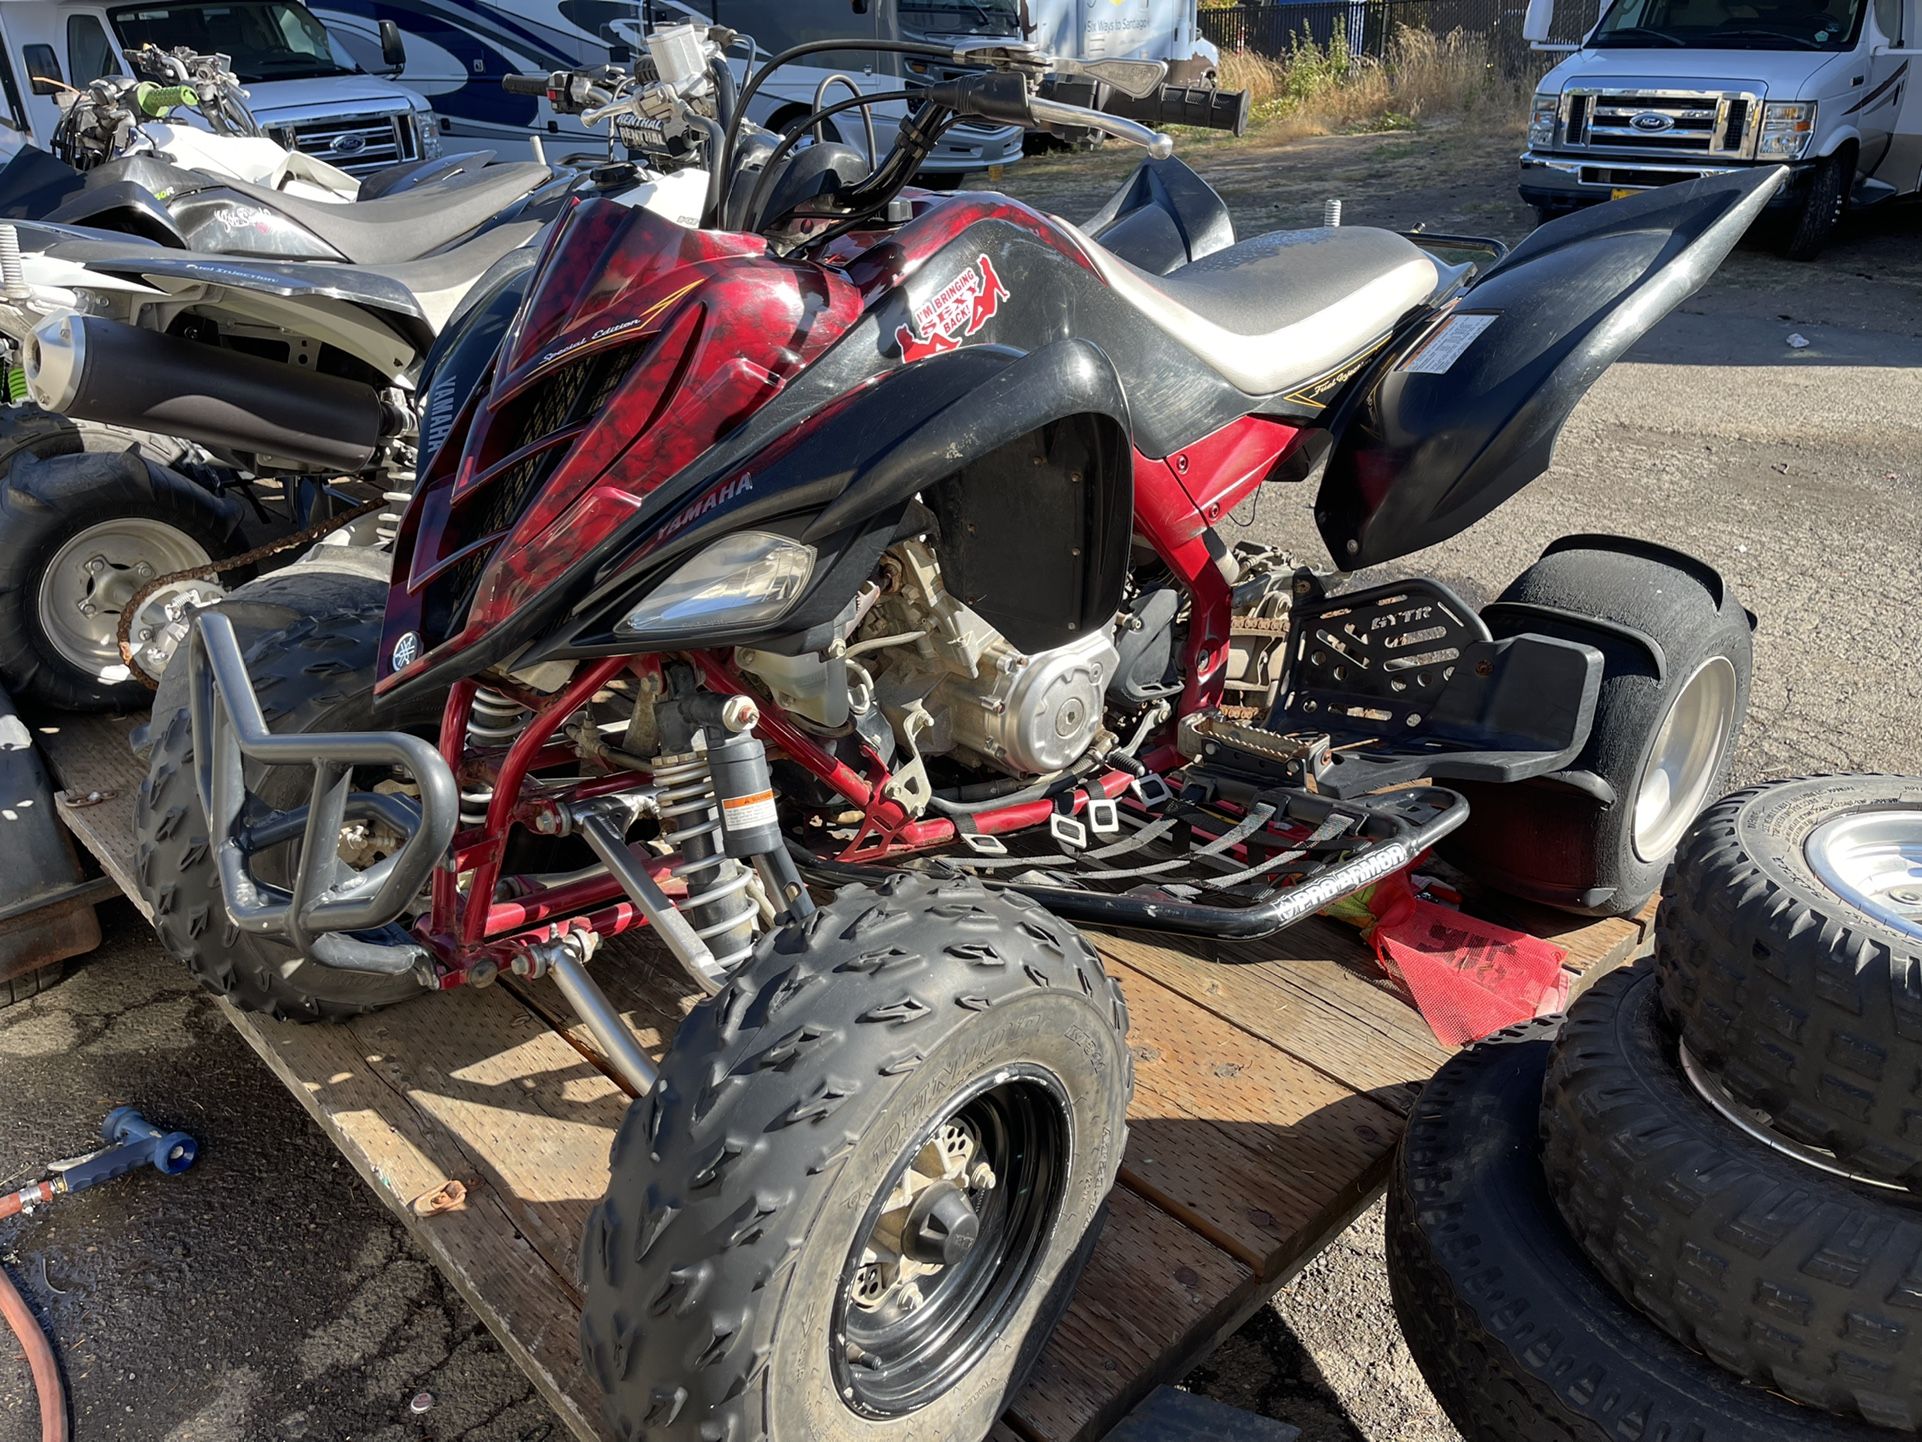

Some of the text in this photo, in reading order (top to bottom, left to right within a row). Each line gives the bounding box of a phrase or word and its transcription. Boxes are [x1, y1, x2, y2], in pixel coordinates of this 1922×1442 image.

[617, 112, 663, 130] RENTHAL
[620, 126, 666, 147] RENTHAL
[915, 269, 975, 323] I'M BRINGING
[920, 279, 977, 337] SEXY
[943, 304, 971, 334] BACK!
[539, 318, 642, 365] Special Edition
[1308, 378, 1337, 399] Fuel
[427, 375, 457, 454] YAMAHA
[656, 471, 754, 542] YAMAHA
[1370, 605, 1433, 631] GYTR
